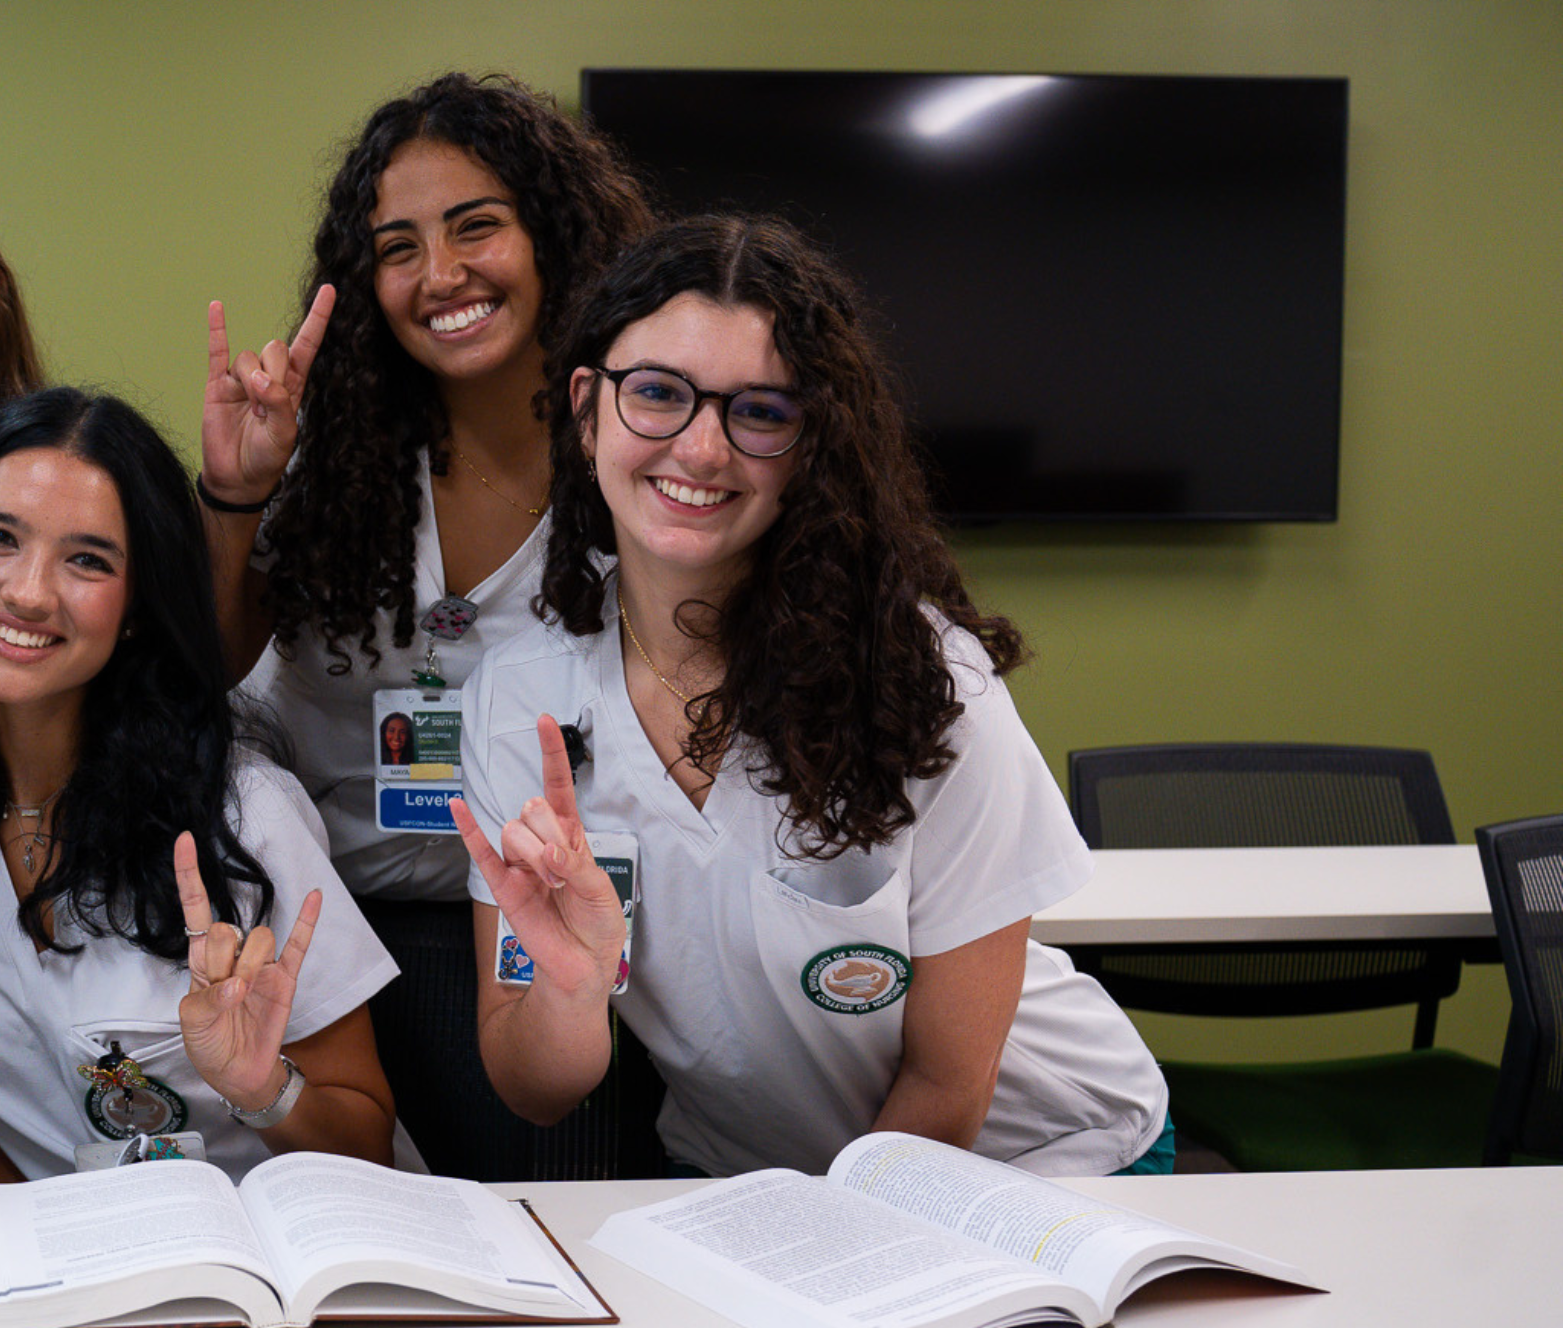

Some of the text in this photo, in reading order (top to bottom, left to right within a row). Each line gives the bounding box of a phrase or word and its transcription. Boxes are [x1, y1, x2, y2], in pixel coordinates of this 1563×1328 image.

[432, 718, 454, 727] SOUTH
[404, 792, 450, 807] Level
[832, 951, 846, 960] OF
[849, 949, 885, 960] SOUTH
[856, 1004, 870, 1012] OF
